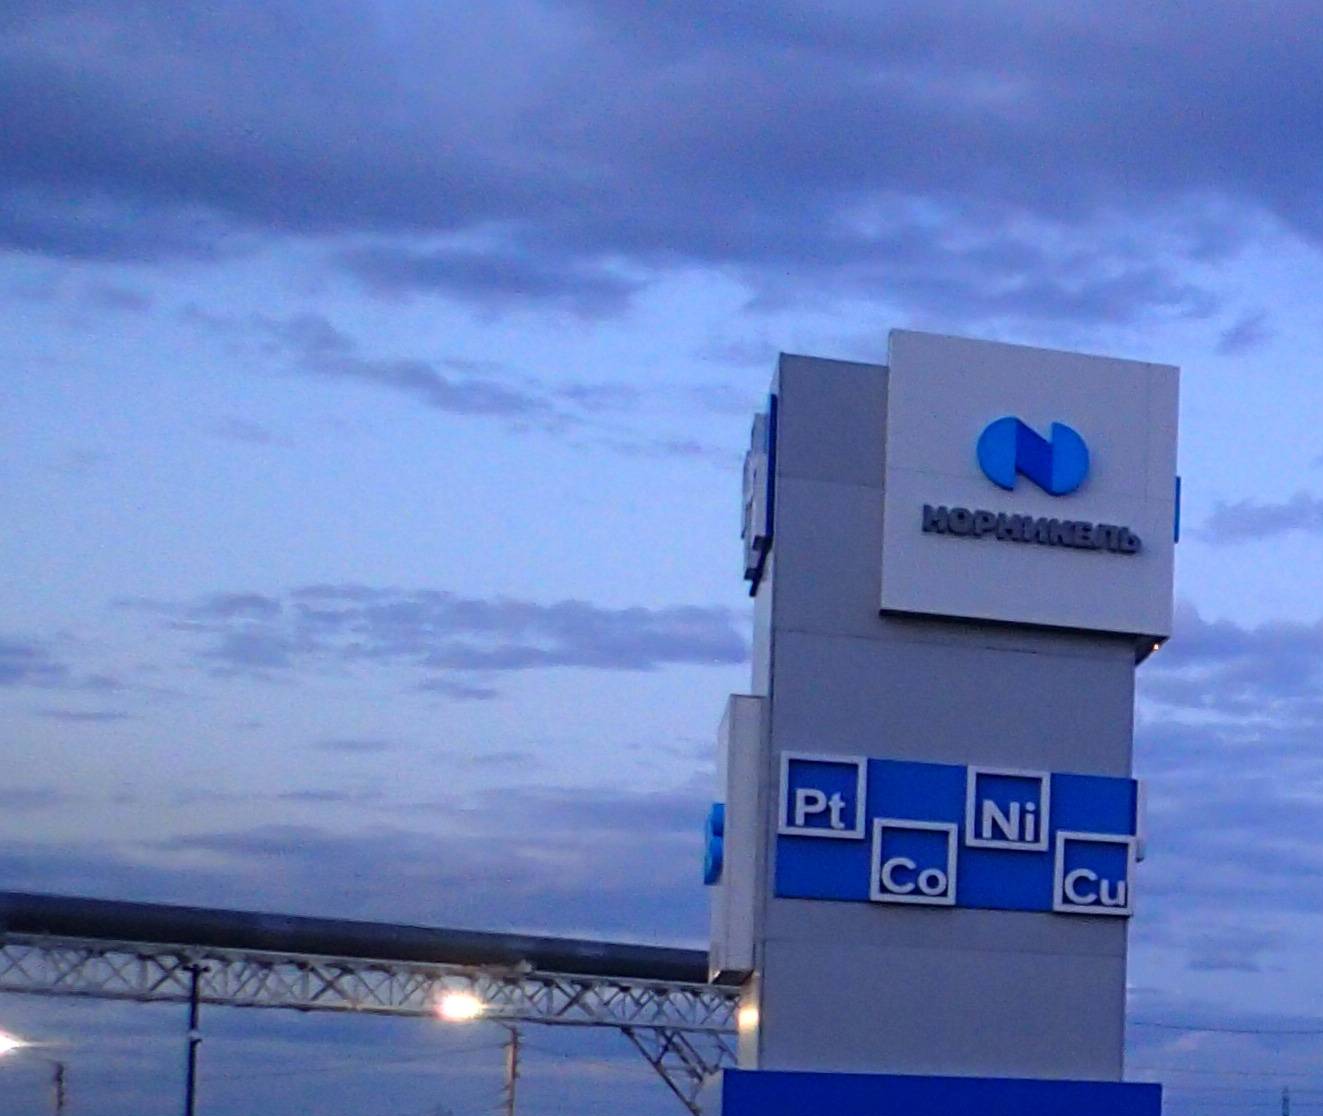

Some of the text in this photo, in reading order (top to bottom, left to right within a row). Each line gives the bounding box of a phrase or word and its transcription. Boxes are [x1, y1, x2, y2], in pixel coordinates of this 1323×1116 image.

[922, 503, 1143, 555] НОРНИКЕЛЬ
[794, 787, 846, 830] Pt
[982, 798, 1037, 842] Ni
[881, 856, 948, 896] Co
[1064, 867, 1126, 906] Cu
